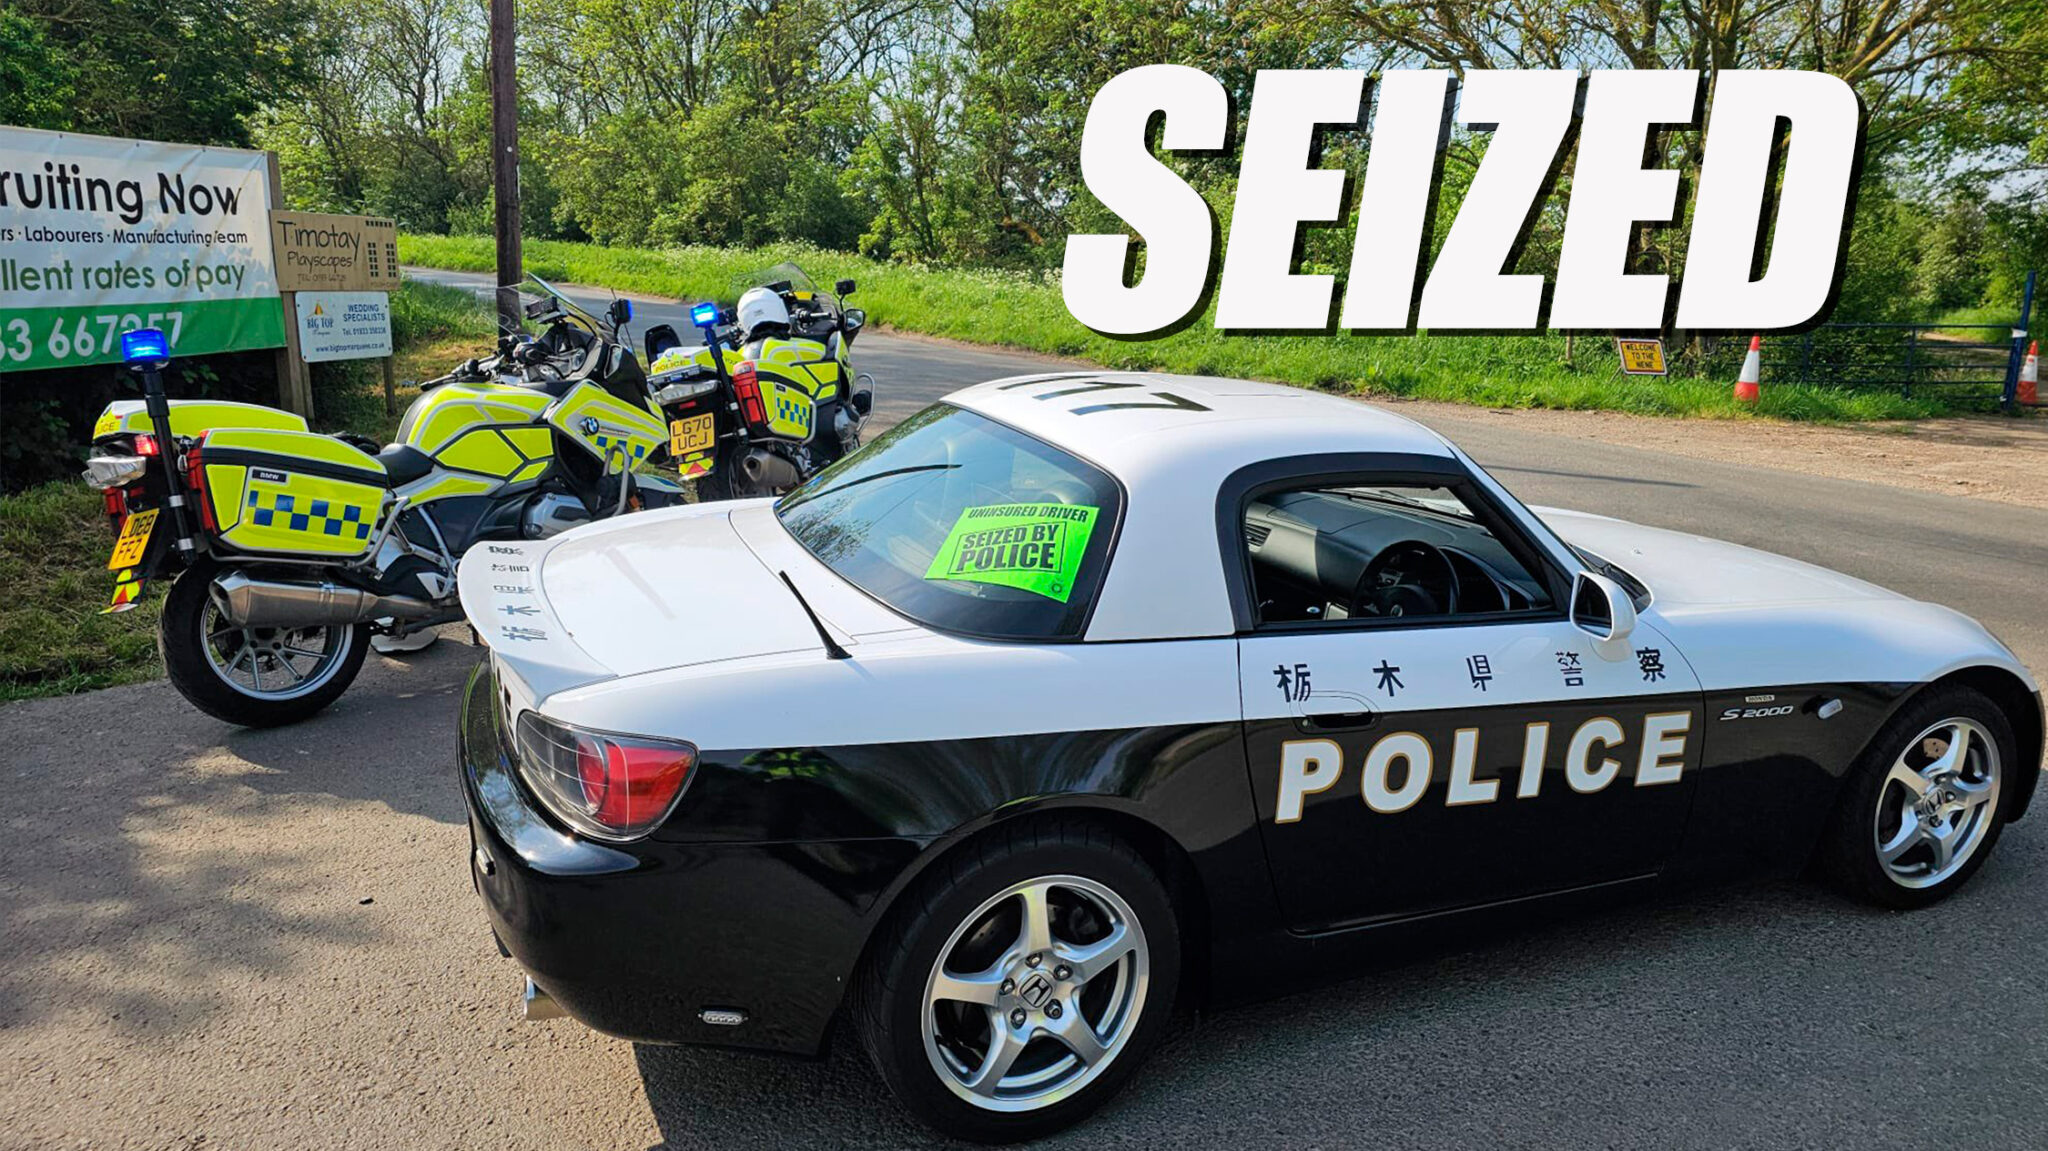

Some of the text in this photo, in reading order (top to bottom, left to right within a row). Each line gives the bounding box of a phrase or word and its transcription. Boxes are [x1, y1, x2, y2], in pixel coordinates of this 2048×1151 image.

[0, 161, 241, 225] ruiting Now
[25, 226, 104, 243] Labourers
[113, 229, 212, 247] Manufacturing
[277, 221, 360, 262] Timotay
[287, 251, 353, 274] Playscapes
[82, 260, 155, 290] rates
[165, 259, 190, 288] of
[196, 265, 245, 293] pay
[343, 313, 386, 322] SPECIALISTS
[347, 304, 379, 313] WEDDING
[307, 317, 334, 329] BIG TOP
[1626, 344, 1657, 352] WELCOME
[1632, 352, 1640, 360] TO
[672, 416, 711, 437] LG70
[678, 432, 707, 450] UCJ
[968, 506, 1089, 523] UNINSURED DRIVER
[963, 524, 1060, 550] SEIZED BY
[956, 542, 1056, 572] POLICE
[1274, 710, 1693, 824] POLICE
